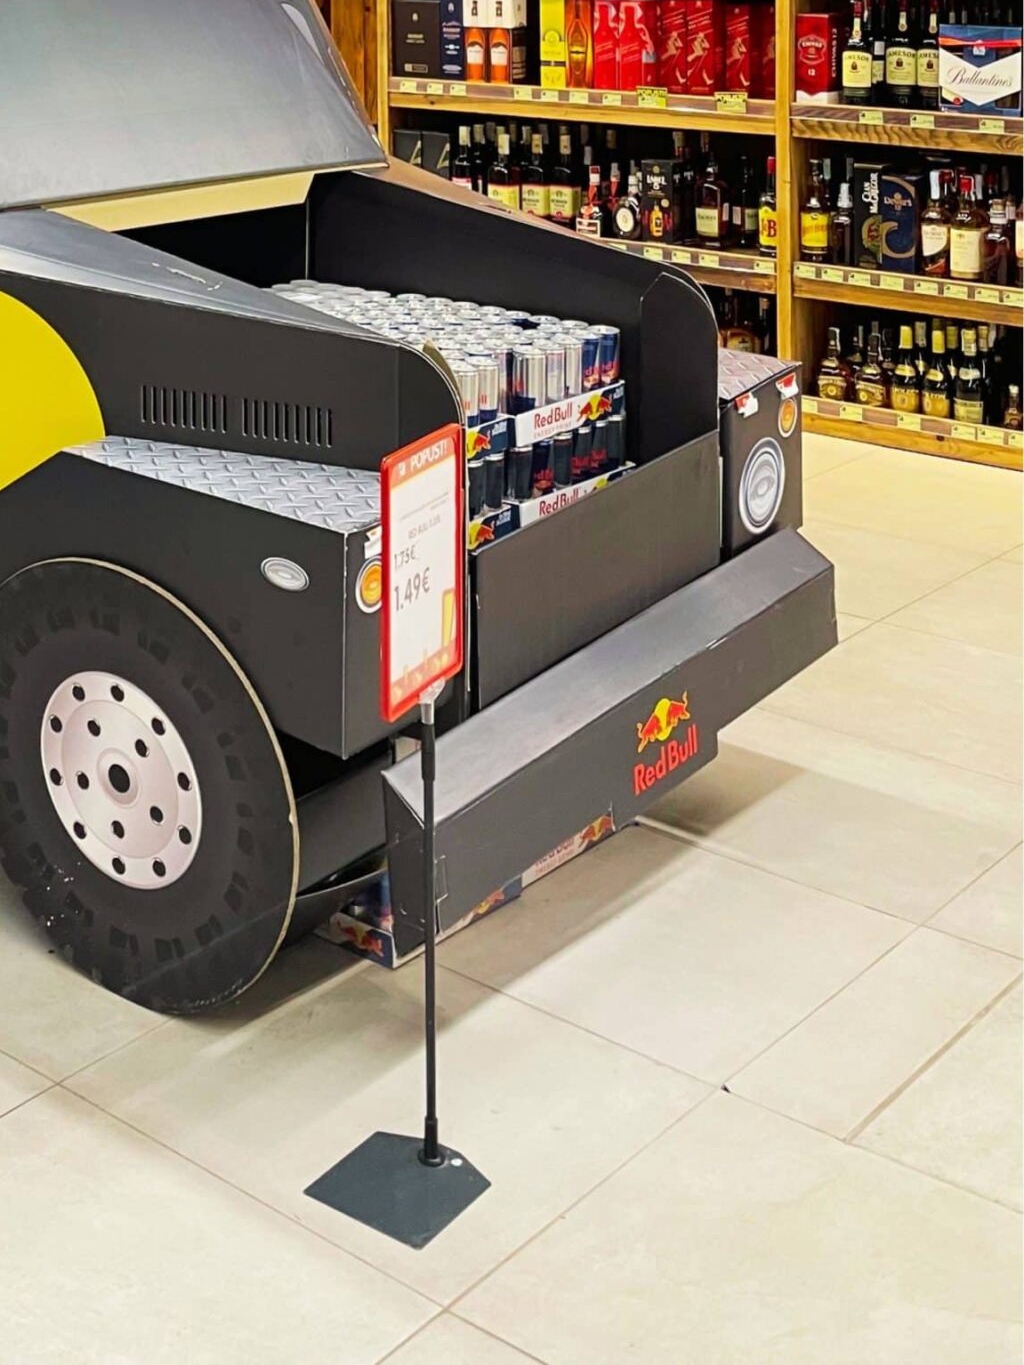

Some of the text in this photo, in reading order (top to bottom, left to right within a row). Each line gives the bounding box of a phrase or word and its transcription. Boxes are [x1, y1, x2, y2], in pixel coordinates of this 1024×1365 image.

[533, 403, 573, 430] Red Bull
[410, 439, 449, 474] POPUST!
[394, 567, 431, 612] 1.49€
[633, 723, 698, 796] Red Bull
